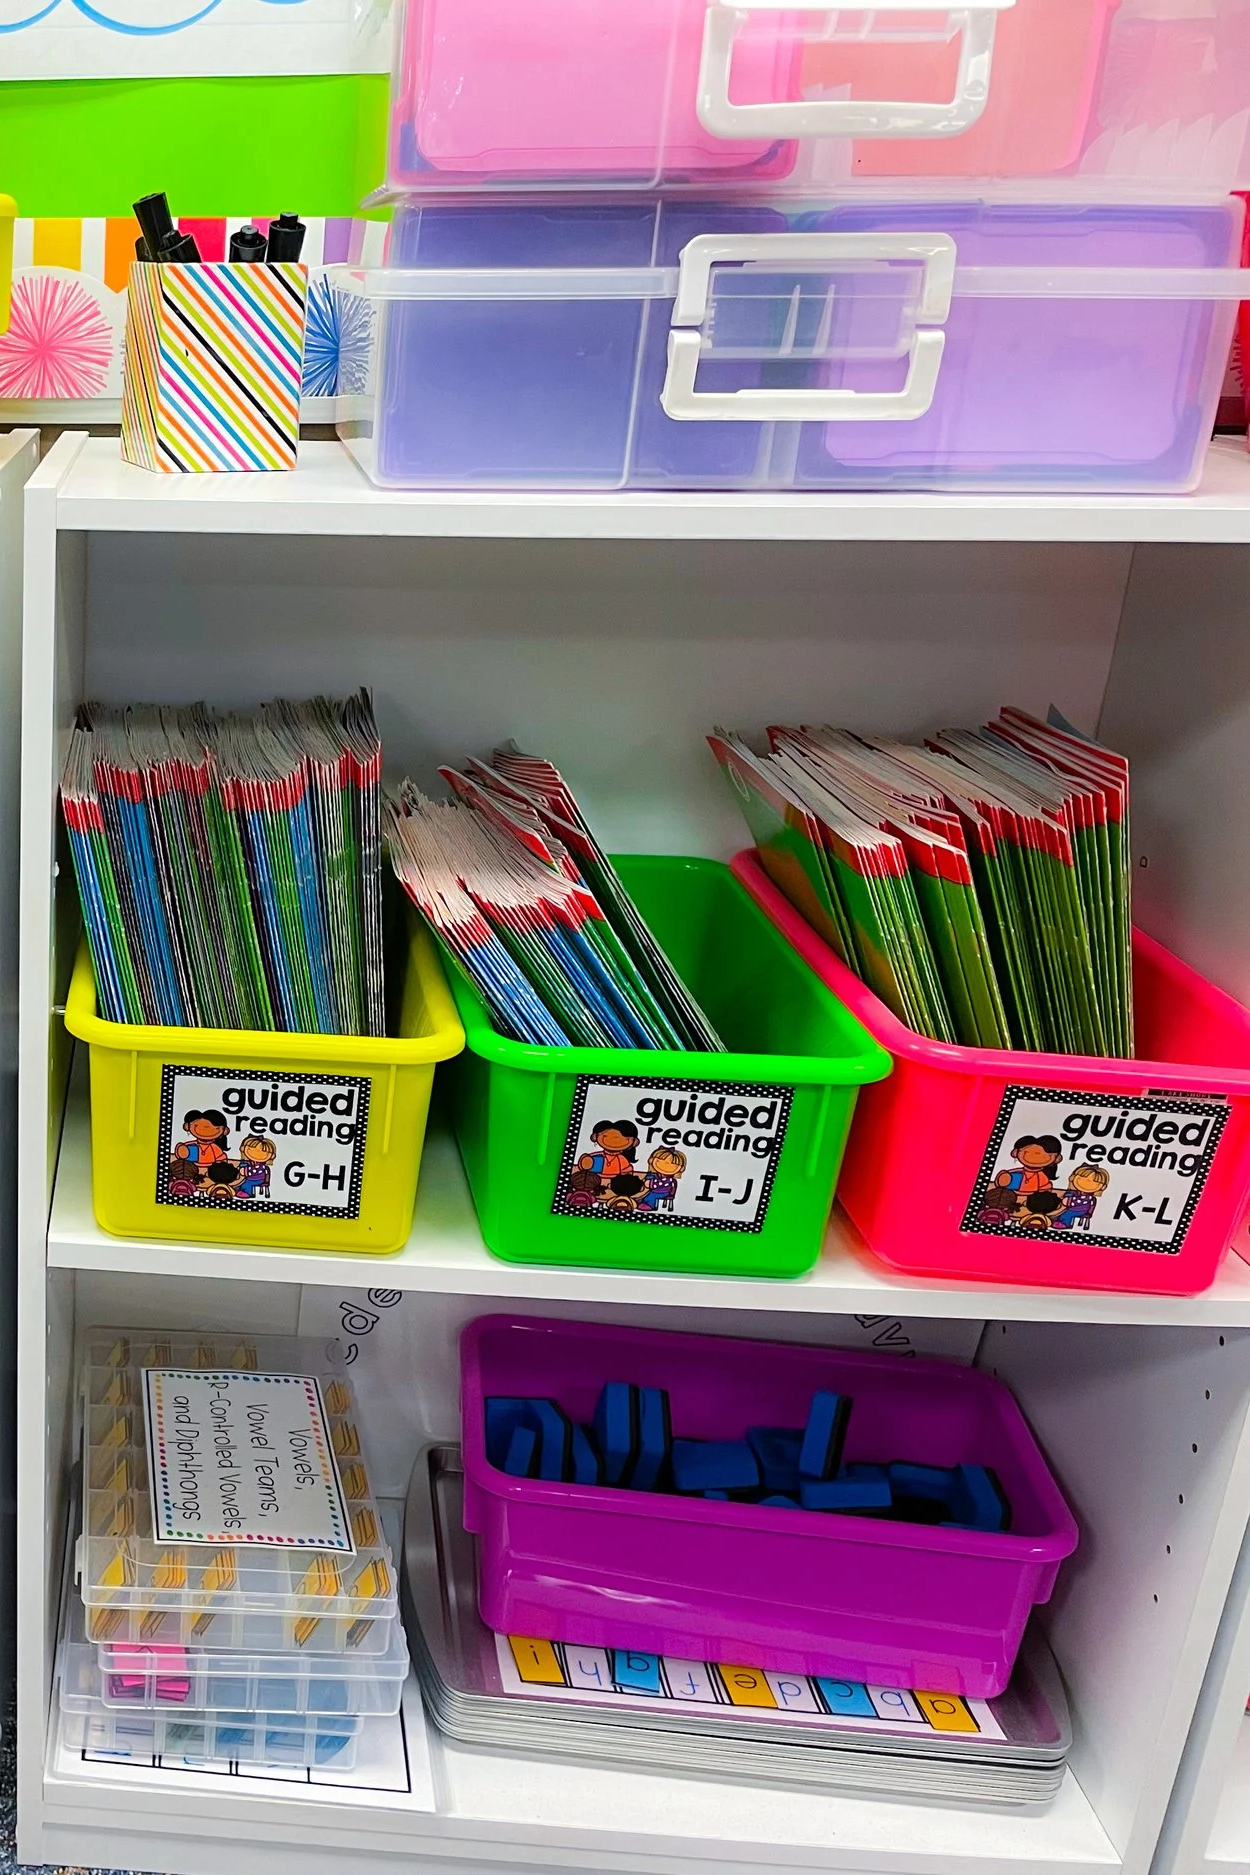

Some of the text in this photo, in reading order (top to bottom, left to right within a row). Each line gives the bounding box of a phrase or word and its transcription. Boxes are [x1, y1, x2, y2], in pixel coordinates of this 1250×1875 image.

[222, 1083, 355, 1116] guided
[635, 1094, 778, 1129] guided
[235, 1114, 357, 1145] reading
[646, 1125, 776, 1159] reading
[1059, 1110, 1210, 1147] guided
[284, 1160, 346, 1192] G-H
[1069, 1142, 1203, 1177] reading
[695, 1174, 754, 1206] I-J
[1113, 1193, 1173, 1226] K-L
[167, 1395, 203, 1521] and Diphthongs
[207, 1382, 247, 1534] R-Controlled Vowels,
[246, 1403, 280, 1517] Vowel Teams,
[288, 1428, 321, 1490] Vowels,
